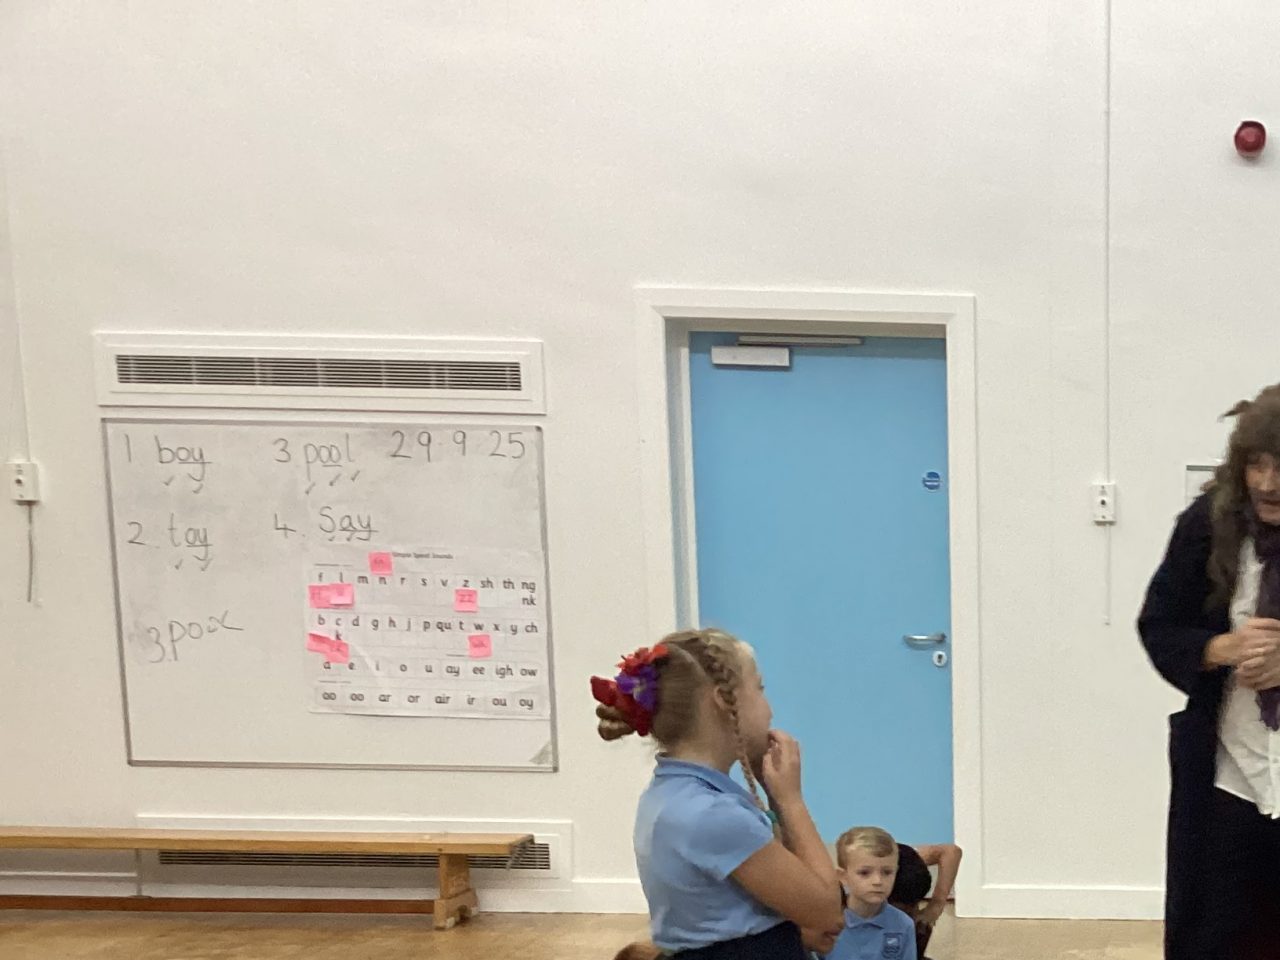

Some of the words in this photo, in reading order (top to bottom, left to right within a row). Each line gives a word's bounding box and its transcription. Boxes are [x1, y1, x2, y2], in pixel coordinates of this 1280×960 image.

[489, 430, 525, 459] 25
[154, 435, 206, 482] boy
[272, 438, 291, 463] 3
[303, 432, 356, 481] pool
[357, 575, 369, 585] m
[378, 576, 387, 585] n
[399, 576, 407, 585] r
[420, 577, 428, 587] s
[440, 579, 449, 588] v
[462, 579, 470, 588] z
[480, 577, 494, 589] sh
[502, 578, 516, 590] th
[520, 581, 537, 594] ng
[521, 594, 537, 606] nk
[317, 613, 326, 626] b
[334, 617, 342, 627] c
[351, 615, 360, 627] d
[371, 618, 379, 631] g
[388, 616, 397, 628] h
[422, 620, 431, 632] p
[435, 621, 453, 633] qu
[458, 620, 466, 631] t
[473, 623, 484, 631] w
[492, 623, 501, 632] x
[509, 624, 518, 636] y
[524, 622, 539, 634] ch
[323, 661, 332, 670] a
[347, 661, 355, 671] e
[399, 663, 408, 673] o
[424, 664, 433, 674] u
[471, 666, 486, 676] ee
[495, 664, 514, 679] igh
[519, 668, 538, 677] ow
[321, 691, 337, 701] oo
[349, 692, 365, 702] oo
[378, 693, 392, 703] ar
[491, 697, 508, 707] ou
